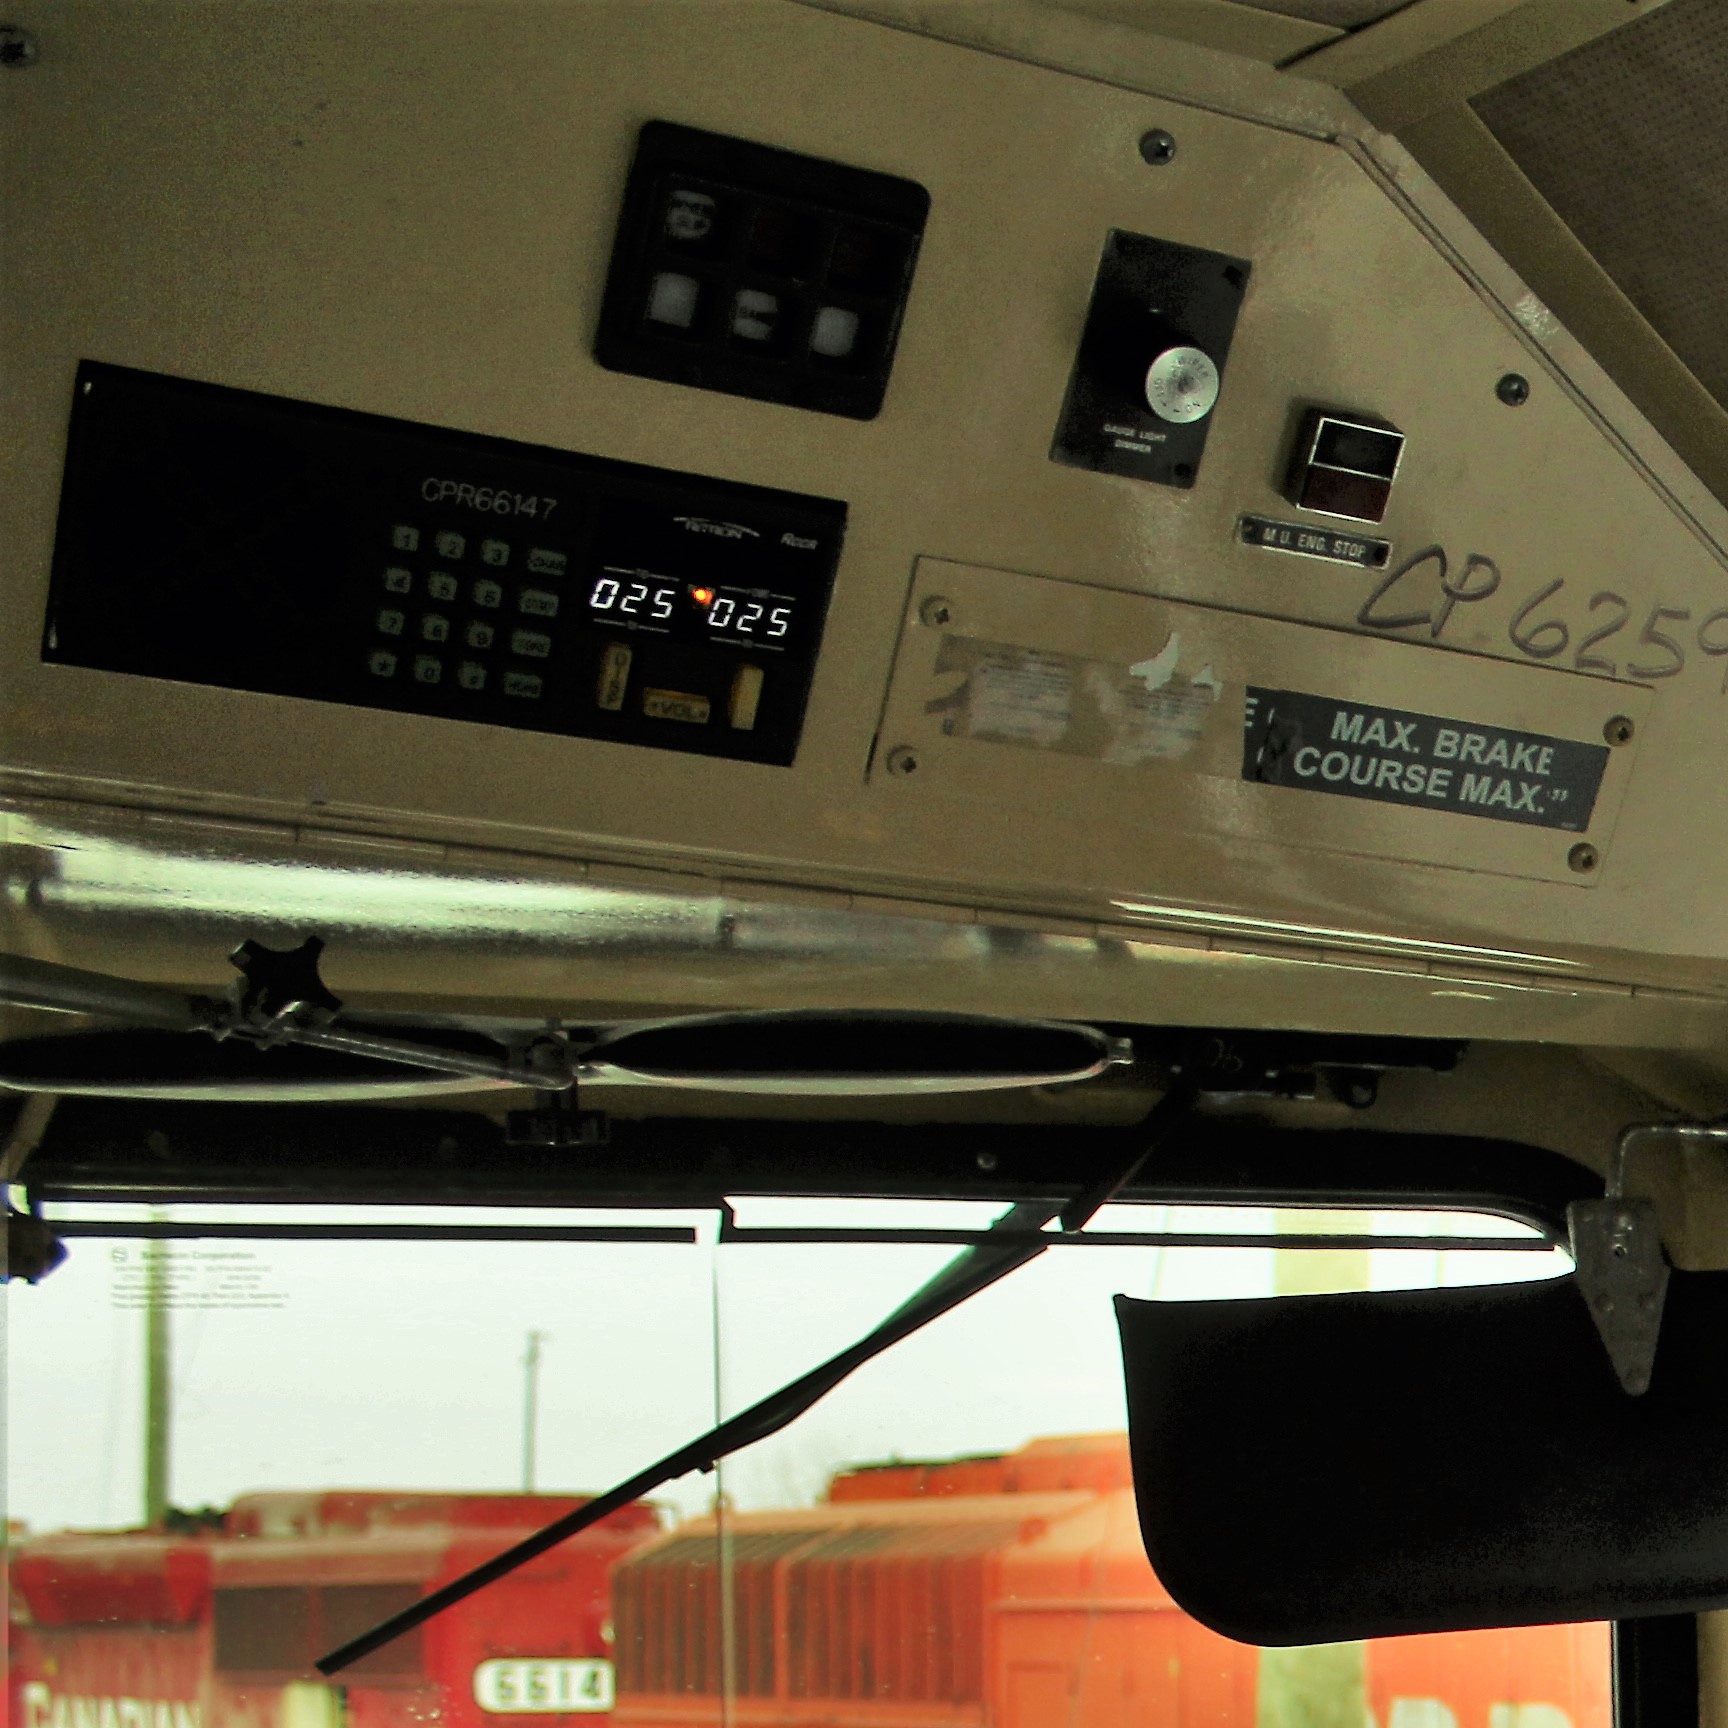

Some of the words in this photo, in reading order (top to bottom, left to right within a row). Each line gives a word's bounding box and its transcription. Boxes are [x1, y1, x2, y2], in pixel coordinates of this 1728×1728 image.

[421, 477, 560, 521] CPR66147
[1333, 539, 1368, 558] STOP
[589, 577, 677, 620] 025
[1356, 543, 1501, 639] CP
[707, 598, 792, 638] 025
[1330, 710, 1421, 754] MAX.
[1433, 728, 1554, 776] BRAKE
[1293, 746, 1454, 800] COURSE
[496, 1663, 600, 1701] 6614
